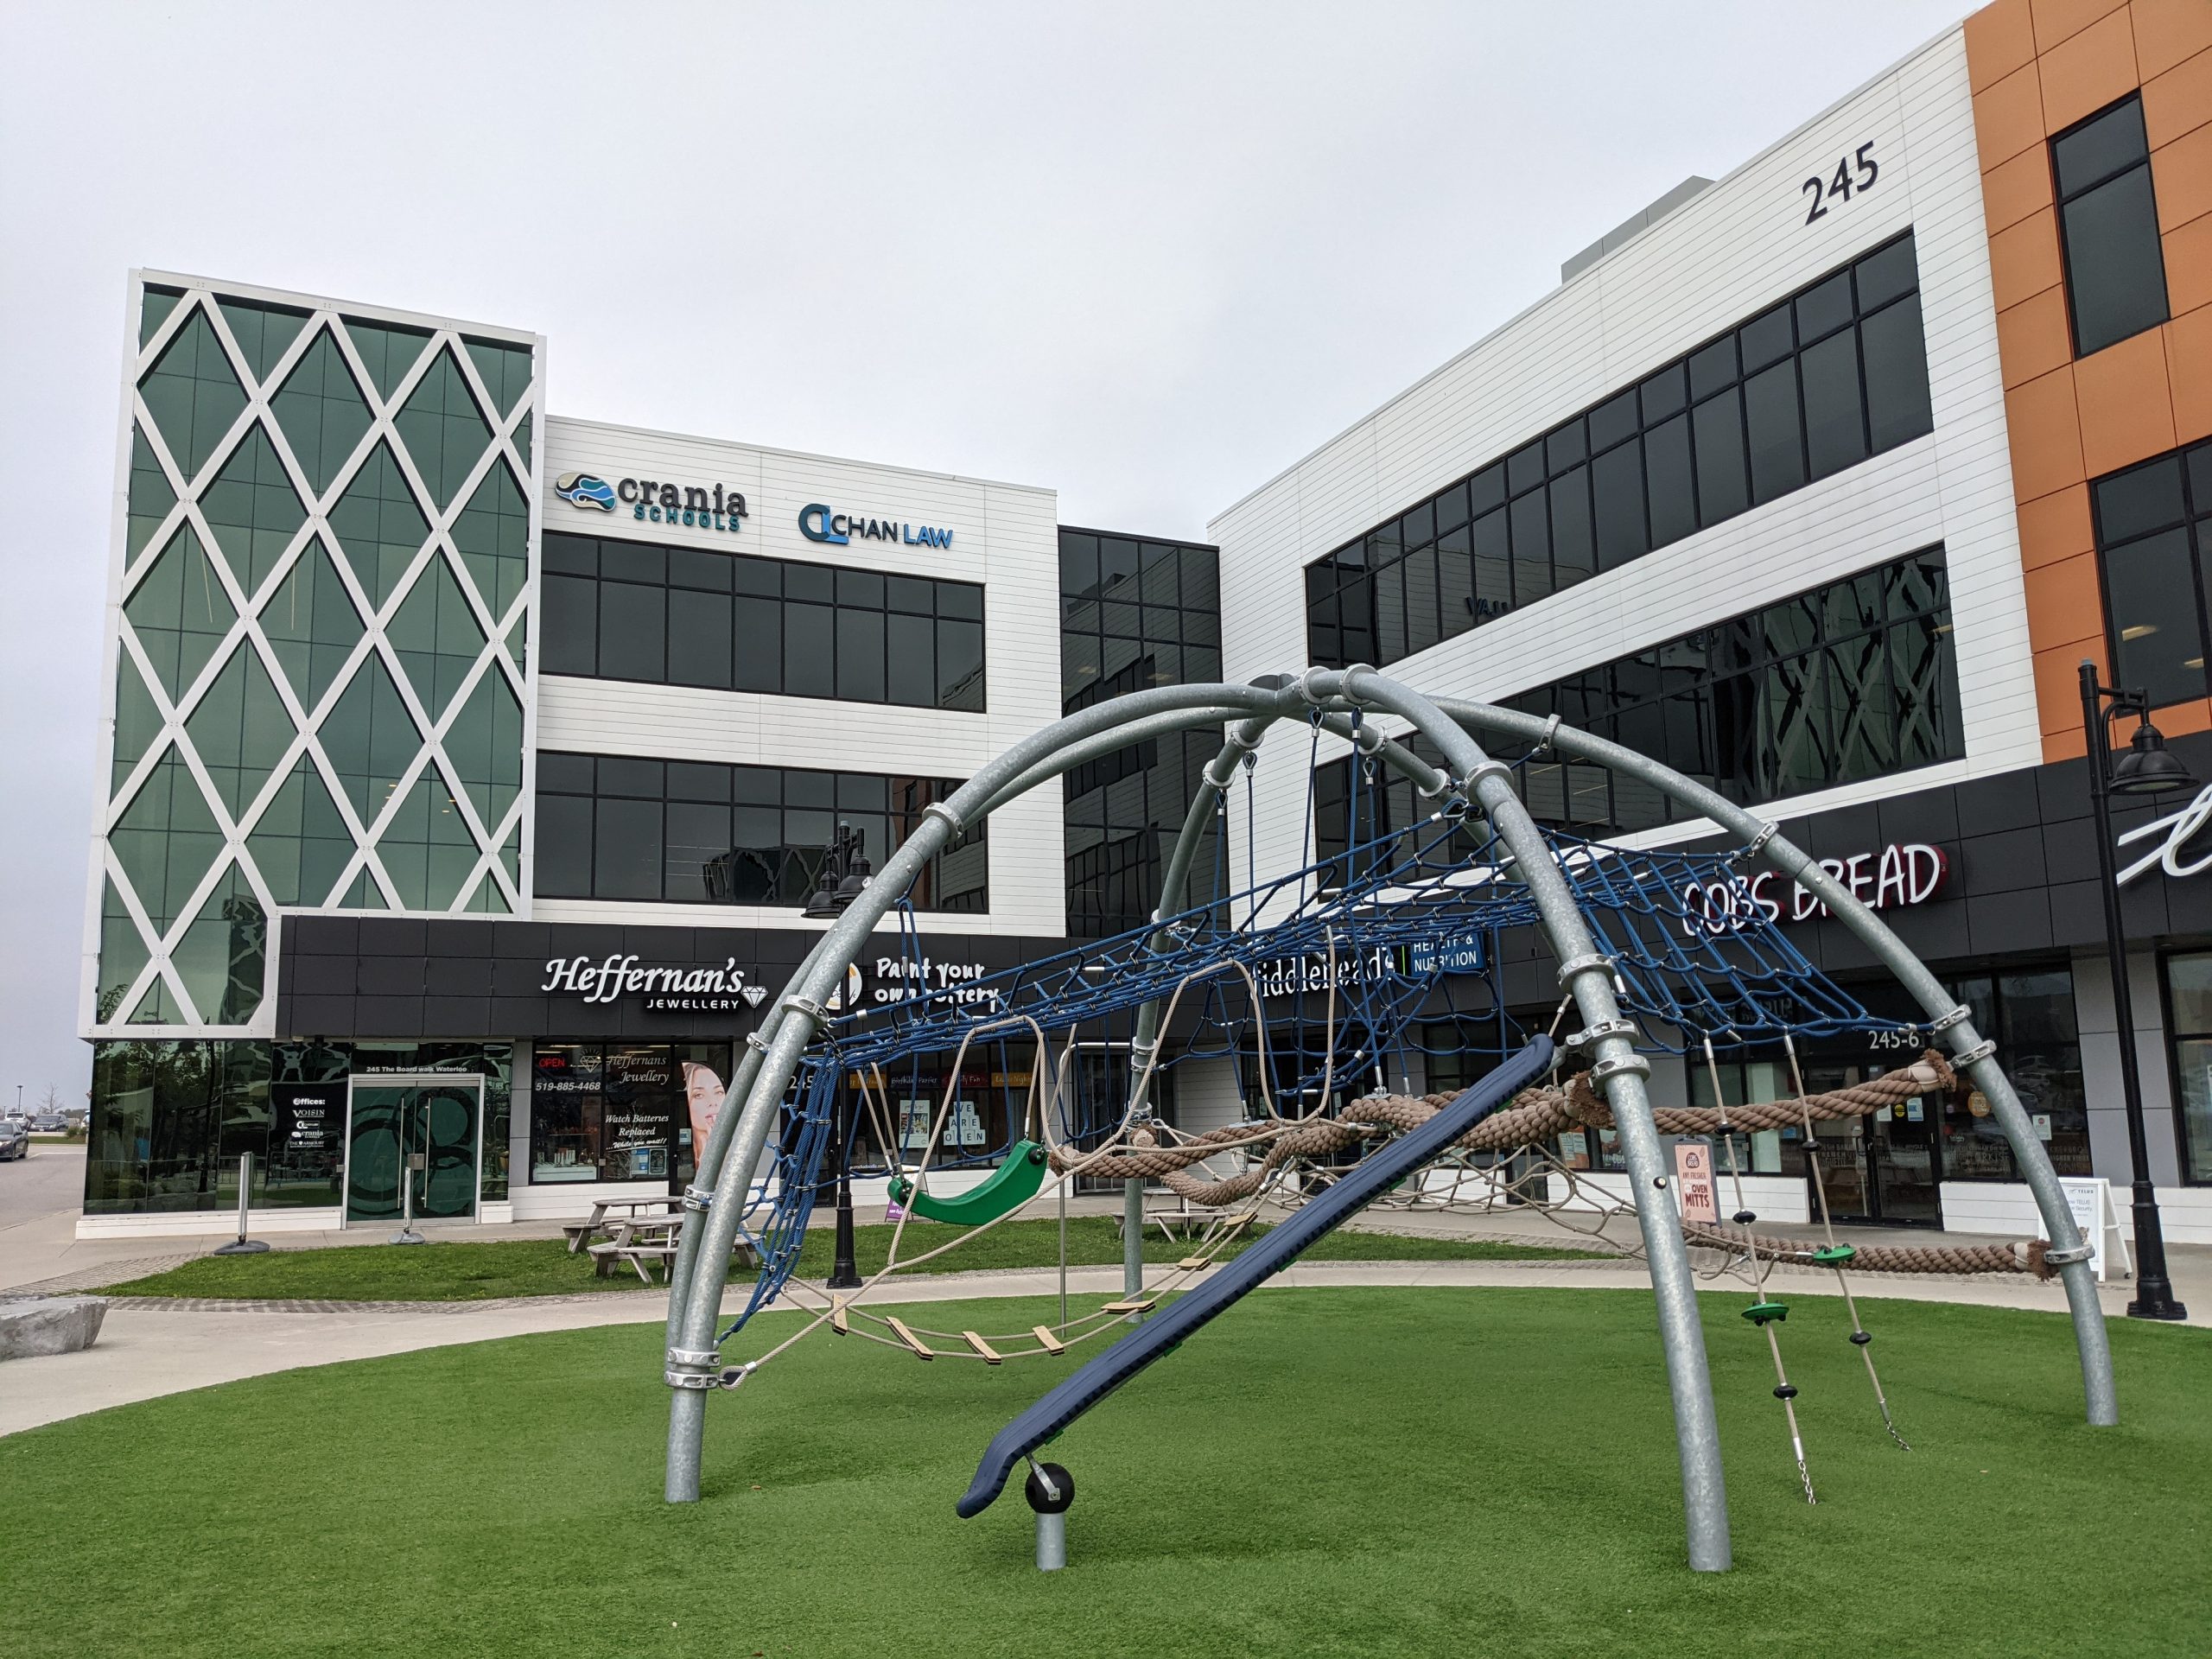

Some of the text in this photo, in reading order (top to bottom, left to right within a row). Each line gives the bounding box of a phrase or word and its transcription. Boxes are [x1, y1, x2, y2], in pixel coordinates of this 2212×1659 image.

[1802, 139, 1878, 226] 245
[617, 477, 749, 518] crania
[633, 504, 741, 532] SCHOOLS
[830, 514, 898, 543] CHAN
[903, 523, 953, 550] LAW
[1681, 844, 1940, 937] COBS BREAD
[540, 954, 745, 1003] Heffernan's
[936, 963, 985, 988] your
[874, 988, 917, 1002] own
[646, 998, 740, 1009] JEWELLERY
[1867, 1030, 1920, 1049] 245-6
[538, 1058, 566, 1068] OPEN
[606, 1052, 667, 1070] Heffernans
[620, 1070, 670, 1085] Jewellery
[536, 1082, 601, 1091] 519-885-4468
[605, 1114, 670, 1123] Watch Batteries
[950, 1119, 977, 1128] ARE
[618, 1127, 656, 1139] Replaced
[944, 1133, 983, 1141] OEN
[1691, 1185, 1708, 1193] OVEN
[1685, 1194, 1710, 1208] MITTS
